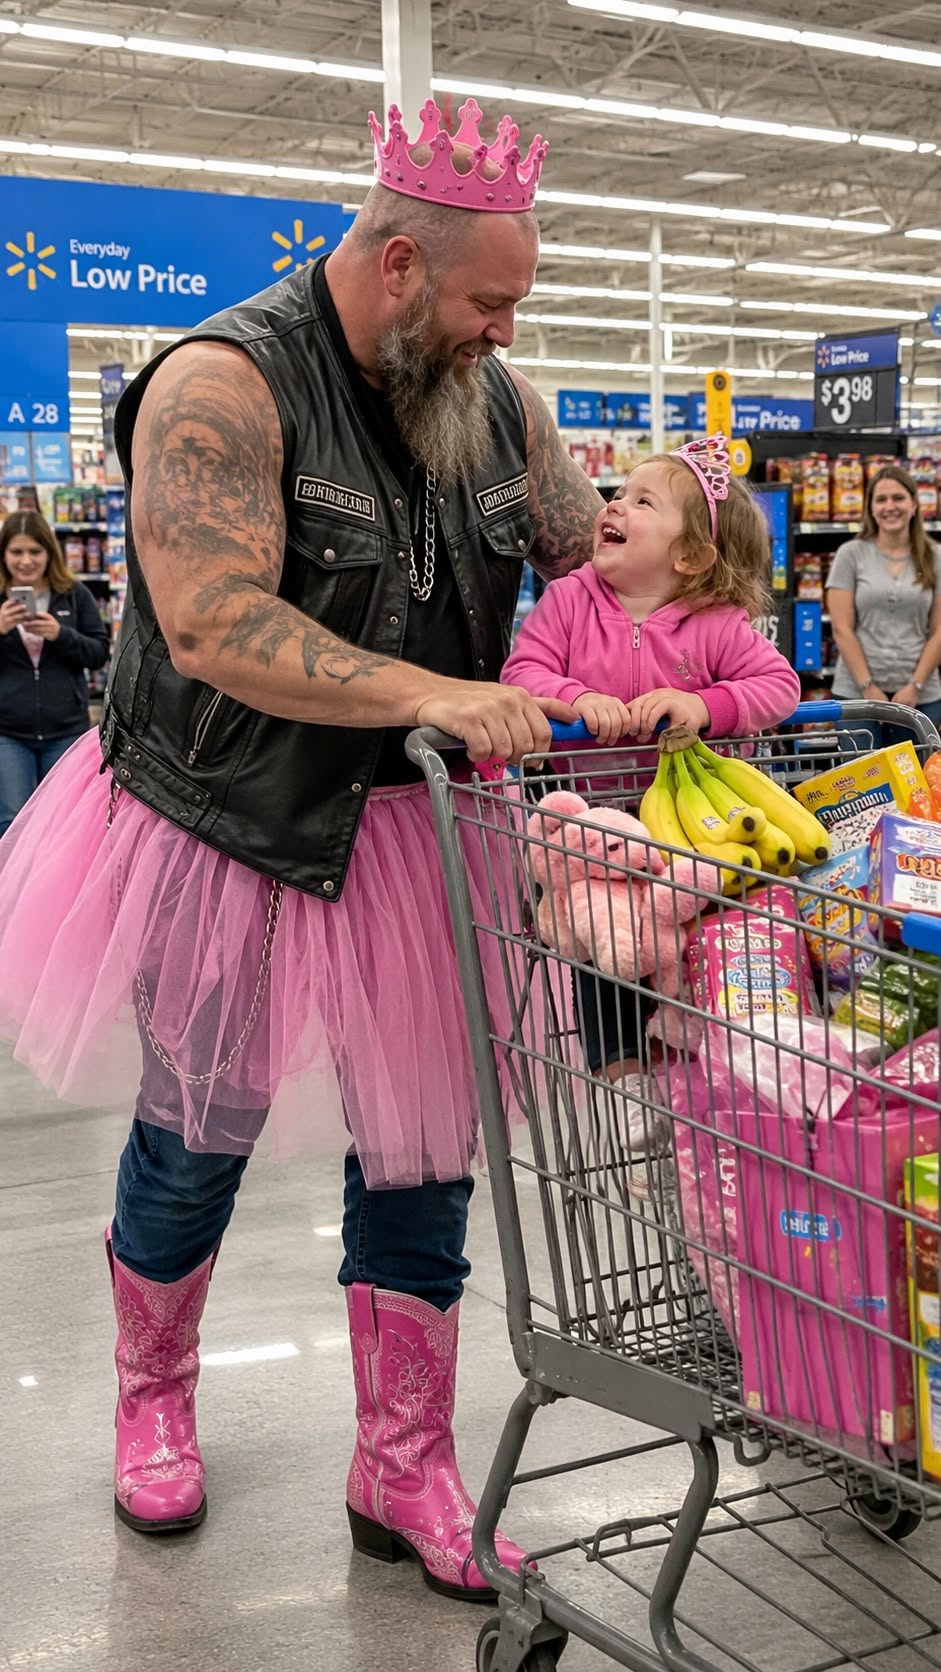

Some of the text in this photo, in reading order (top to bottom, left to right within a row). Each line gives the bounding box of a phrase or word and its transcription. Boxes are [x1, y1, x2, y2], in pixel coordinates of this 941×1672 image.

[69, 239, 131, 260] Everyday
[70, 259, 208, 296] Low Price
[848, 349, 870, 364] Price
[8, 402, 59, 425] A 28
